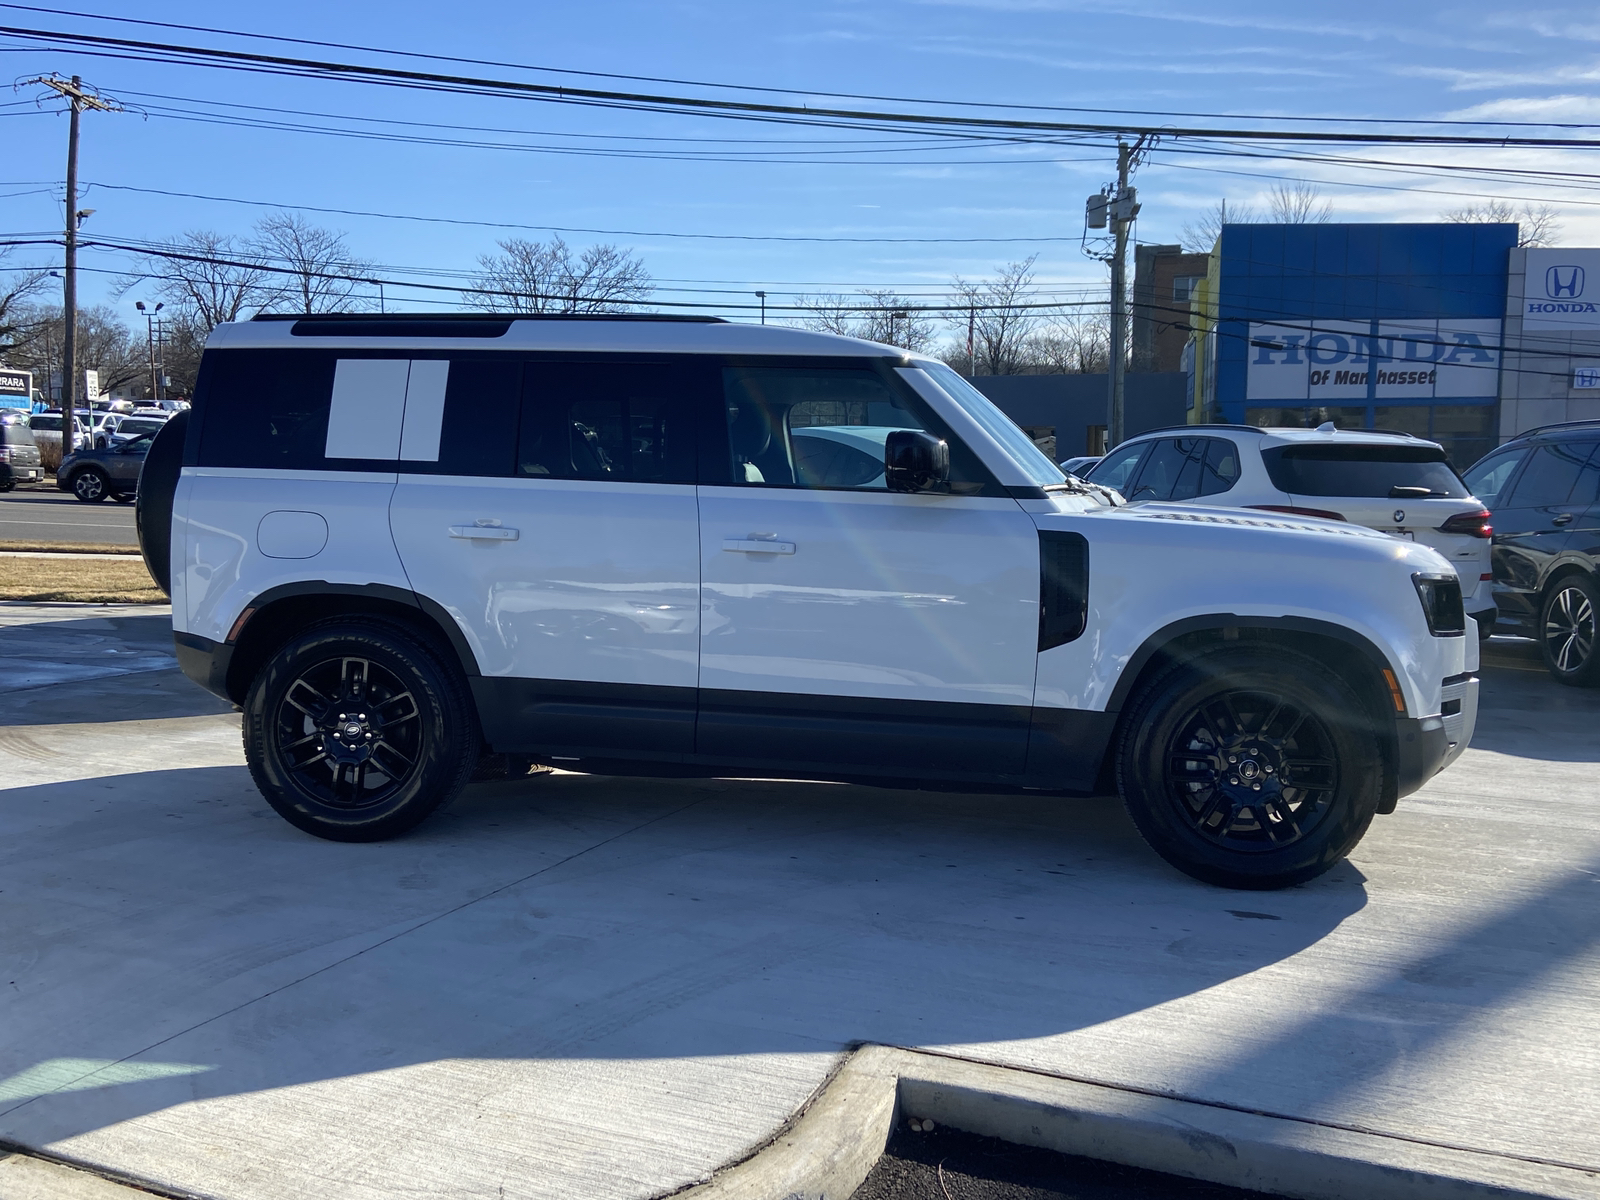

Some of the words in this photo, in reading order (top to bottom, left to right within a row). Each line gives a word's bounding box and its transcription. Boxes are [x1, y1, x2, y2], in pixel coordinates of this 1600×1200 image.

[1528, 303, 1597, 313] HONDA
[1252, 333, 1495, 365] HONDA
[1310, 370, 1330, 385] Of
[1334, 369, 1437, 385] Manhasset
[89, 386, 98, 397] 35
